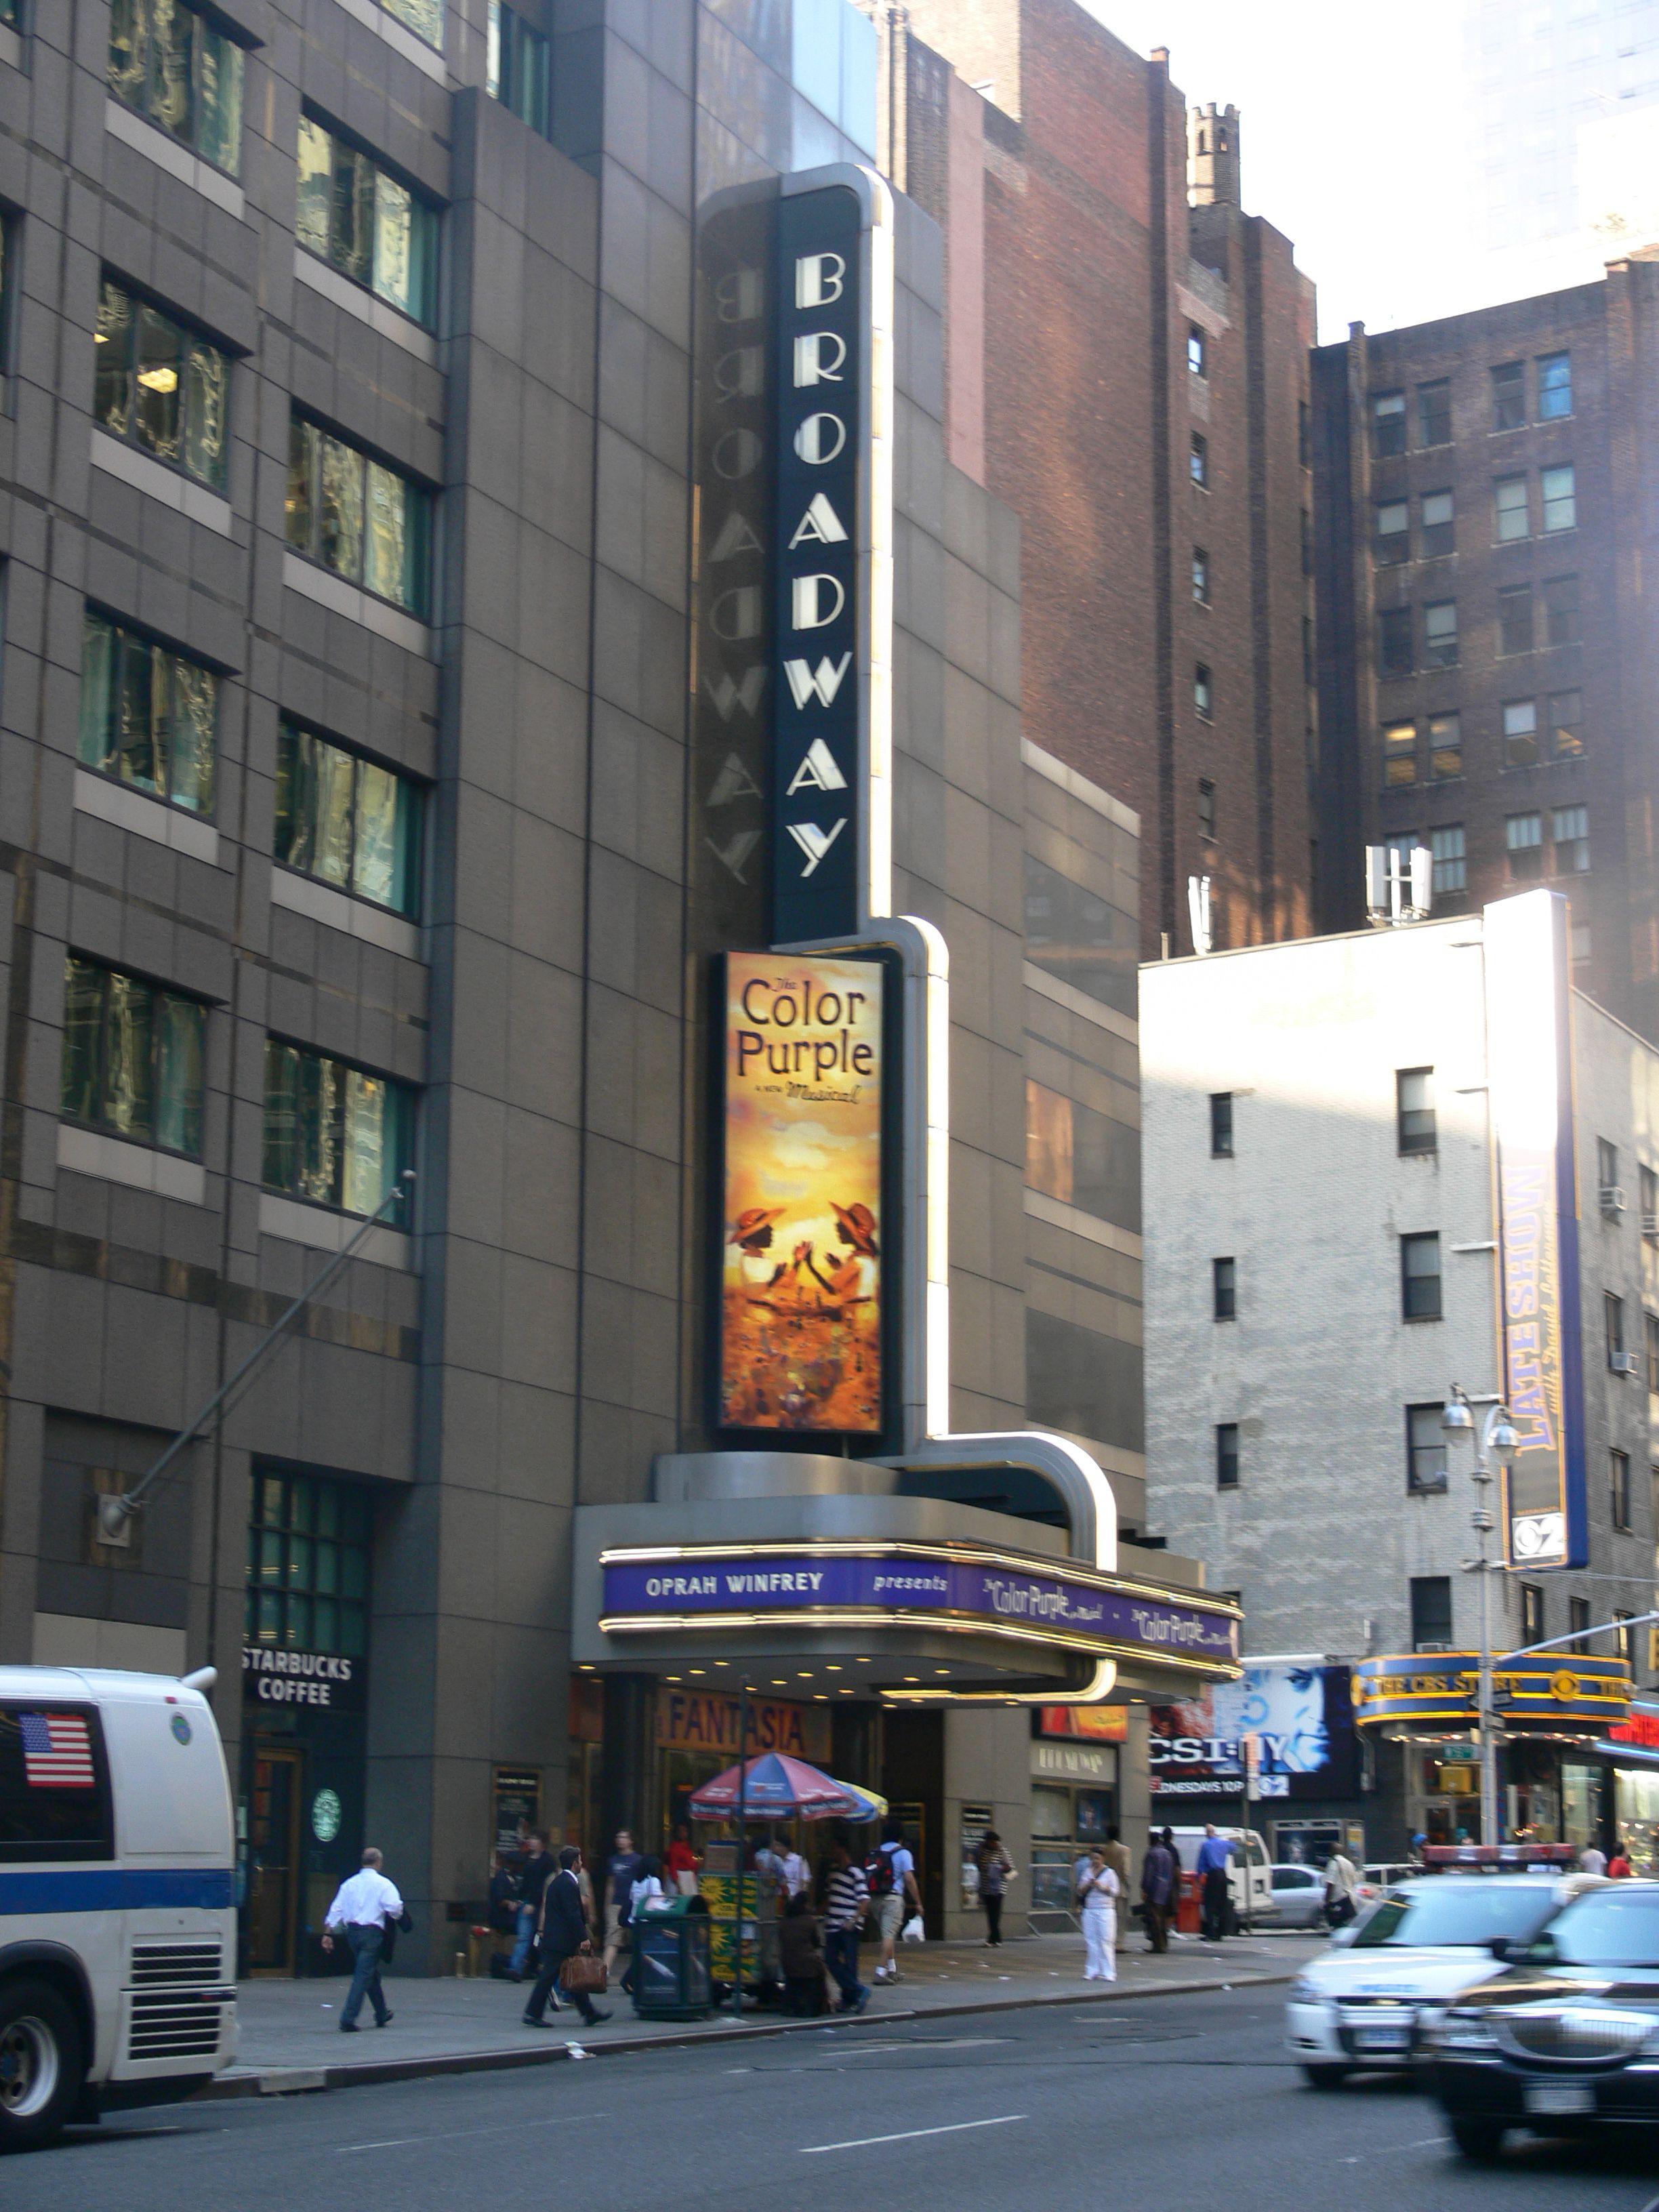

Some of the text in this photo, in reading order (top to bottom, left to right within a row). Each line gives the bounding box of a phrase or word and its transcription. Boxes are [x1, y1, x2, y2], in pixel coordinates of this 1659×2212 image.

[782, 251, 853, 878] BROADWAY
[742, 978, 866, 1027] Color
[771, 977, 800, 992] The
[736, 1028, 872, 1082] Purple
[1501, 1164, 1546, 1319] SHOW
[1506, 1322, 1557, 1457] LATE
[646, 1572, 948, 1597] OPRAH WINFREY presents
[991, 1580, 1029, 1614] Color
[1029, 1584, 1069, 1620] Purple
[1139, 1611, 1171, 1641] Color
[1170, 1614, 1204, 1646] Purple
[242, 1647, 352, 1681] STARBUCKS
[258, 1677, 331, 1706] COFFEE
[1374, 1675, 1522, 1694] THE CBS STRE
[670, 1695, 804, 1753] FANTASIA
